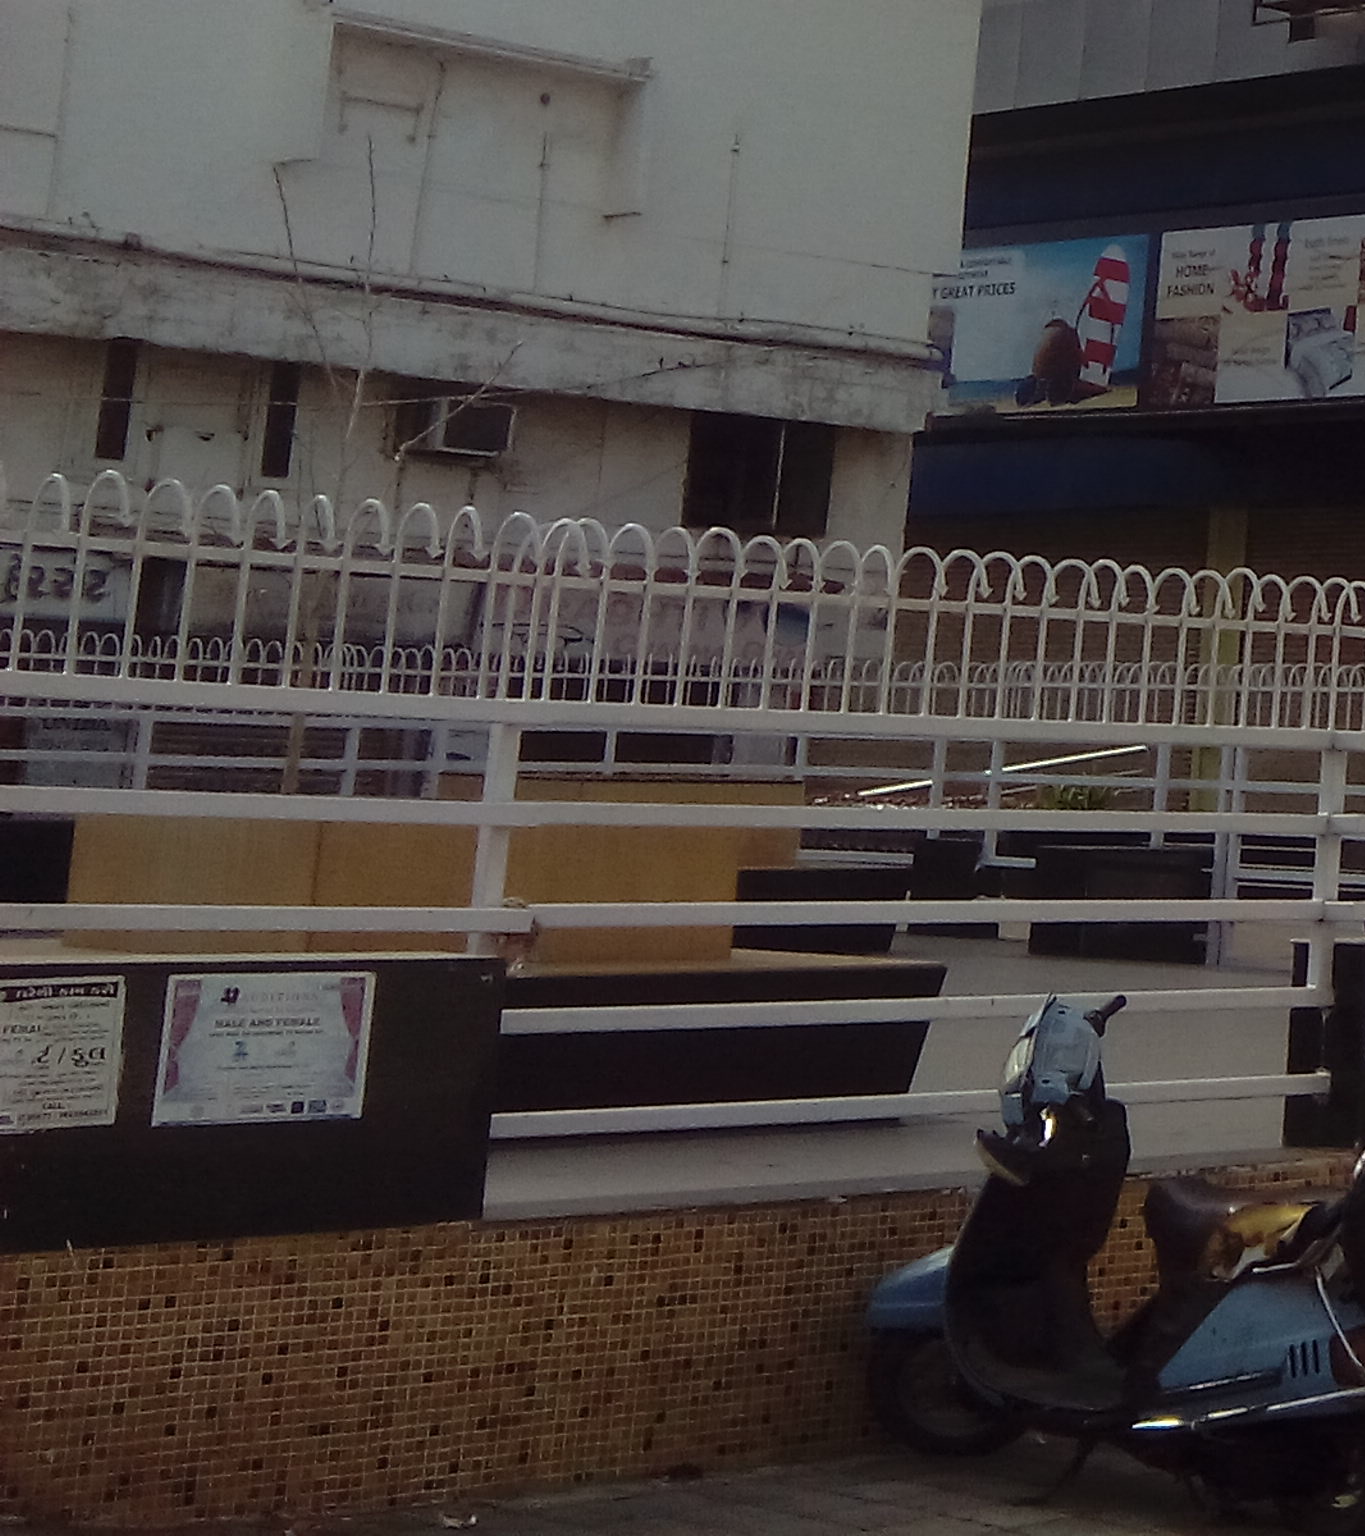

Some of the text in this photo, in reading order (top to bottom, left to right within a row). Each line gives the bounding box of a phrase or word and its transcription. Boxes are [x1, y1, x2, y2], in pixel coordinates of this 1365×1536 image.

[1176, 264, 1209, 279] HOME
[940, 284, 975, 300] GREAT
[976, 281, 1016, 297] PRICES
[1166, 282, 1215, 298] FASHION
